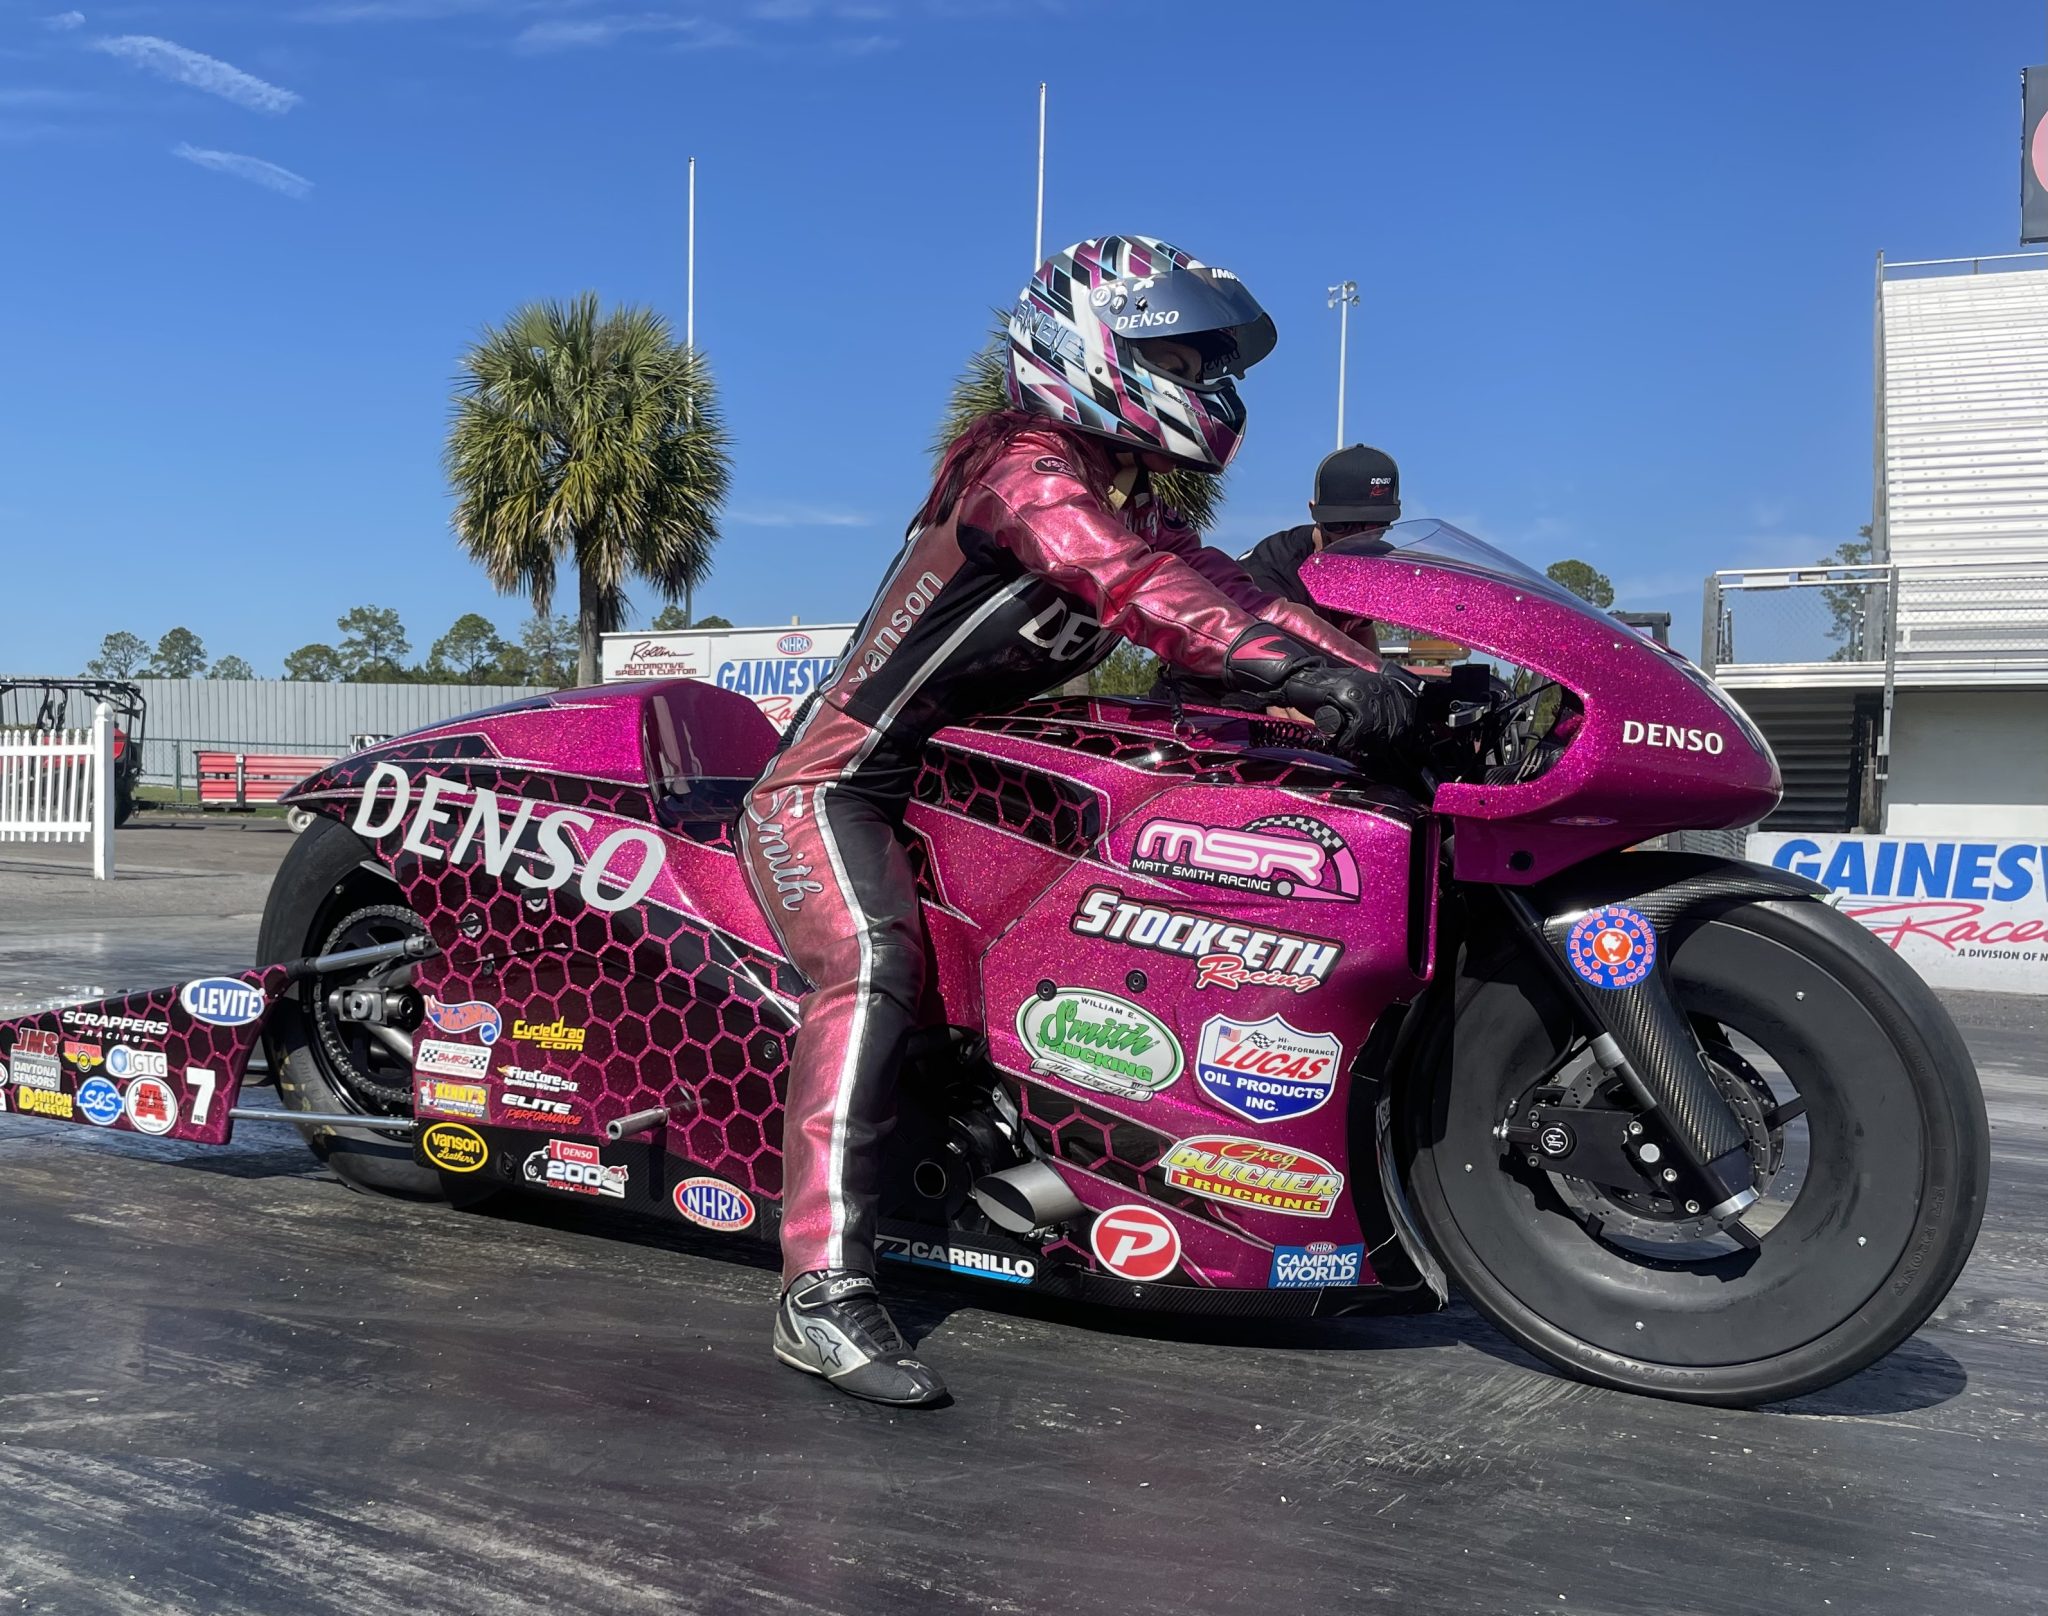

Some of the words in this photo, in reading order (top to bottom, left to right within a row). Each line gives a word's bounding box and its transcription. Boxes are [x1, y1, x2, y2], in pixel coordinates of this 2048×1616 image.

[1114, 310, 1180, 331] DENSO
[849, 570, 945, 683] vanson
[780, 636, 809, 652] NHRA
[624, 662, 685, 670] AUTOMOTIVE
[716, 659, 838, 695] GAINESV
[1622, 720, 1724, 755] DENSO
[352, 761, 667, 912] DENSO
[1136, 819, 1326, 887] MSR
[1132, 859, 1170, 875] MATT
[1172, 865, 1215, 882] SMITH
[1218, 873, 1272, 892] RACING
[1771, 839, 2048, 902] GAINES
[1074, 890, 1339, 977] STOCKSETH
[1958, 948, 1966, 957] A
[1968, 949, 2020, 960] DIVISION
[2022, 952, 2038, 961] OF
[1197, 953, 1321, 991] Racing
[185, 981, 260, 1019] CLEVITE
[1081, 996, 1124, 1016] WILLIAM
[1127, 1011, 1137, 1020] E.
[63, 1010, 169, 1035] SCRAPPERS
[1040, 999, 1160, 1056] Smith
[12, 1028, 59, 1057] JMS
[86, 1029, 140, 1043] RACING
[1214, 1044, 1331, 1081] LUCAS
[1276, 1044, 1336, 1057] PERFORMANCE
[13, 1071, 56, 1089] SENSORS
[14, 1061, 57, 1078] DAYTONA
[186, 1066, 216, 1125] 7
[1204, 1070, 1232, 1087] OIL
[1236, 1077, 1326, 1100] PRODUCTS
[33, 1099, 73, 1118] SLEEVES
[83, 1089, 116, 1112] S&S
[501, 1093, 572, 1115] ELITE
[1245, 1095, 1279, 1112] INC.
[506, 1108, 582, 1126] PERFORMANCE
[431, 1132, 481, 1154] vanson
[563, 1147, 593, 1160] DENSO
[1220, 1142, 1299, 1170] Greg
[546, 1160, 602, 1187] 200
[1169, 1147, 1340, 1196] BUTCHER
[686, 1179, 740, 1195] CHAMPIONSHIP
[1177, 1172, 1323, 1211] TRUCKING
[686, 1187, 743, 1221] NHRA
[911, 1241, 1035, 1279] CARRILLO
[1276, 1252, 1358, 1267] CAMPING
[1310, 1244, 1333, 1252] NHRA
[1276, 1265, 1356, 1281] WORLD
